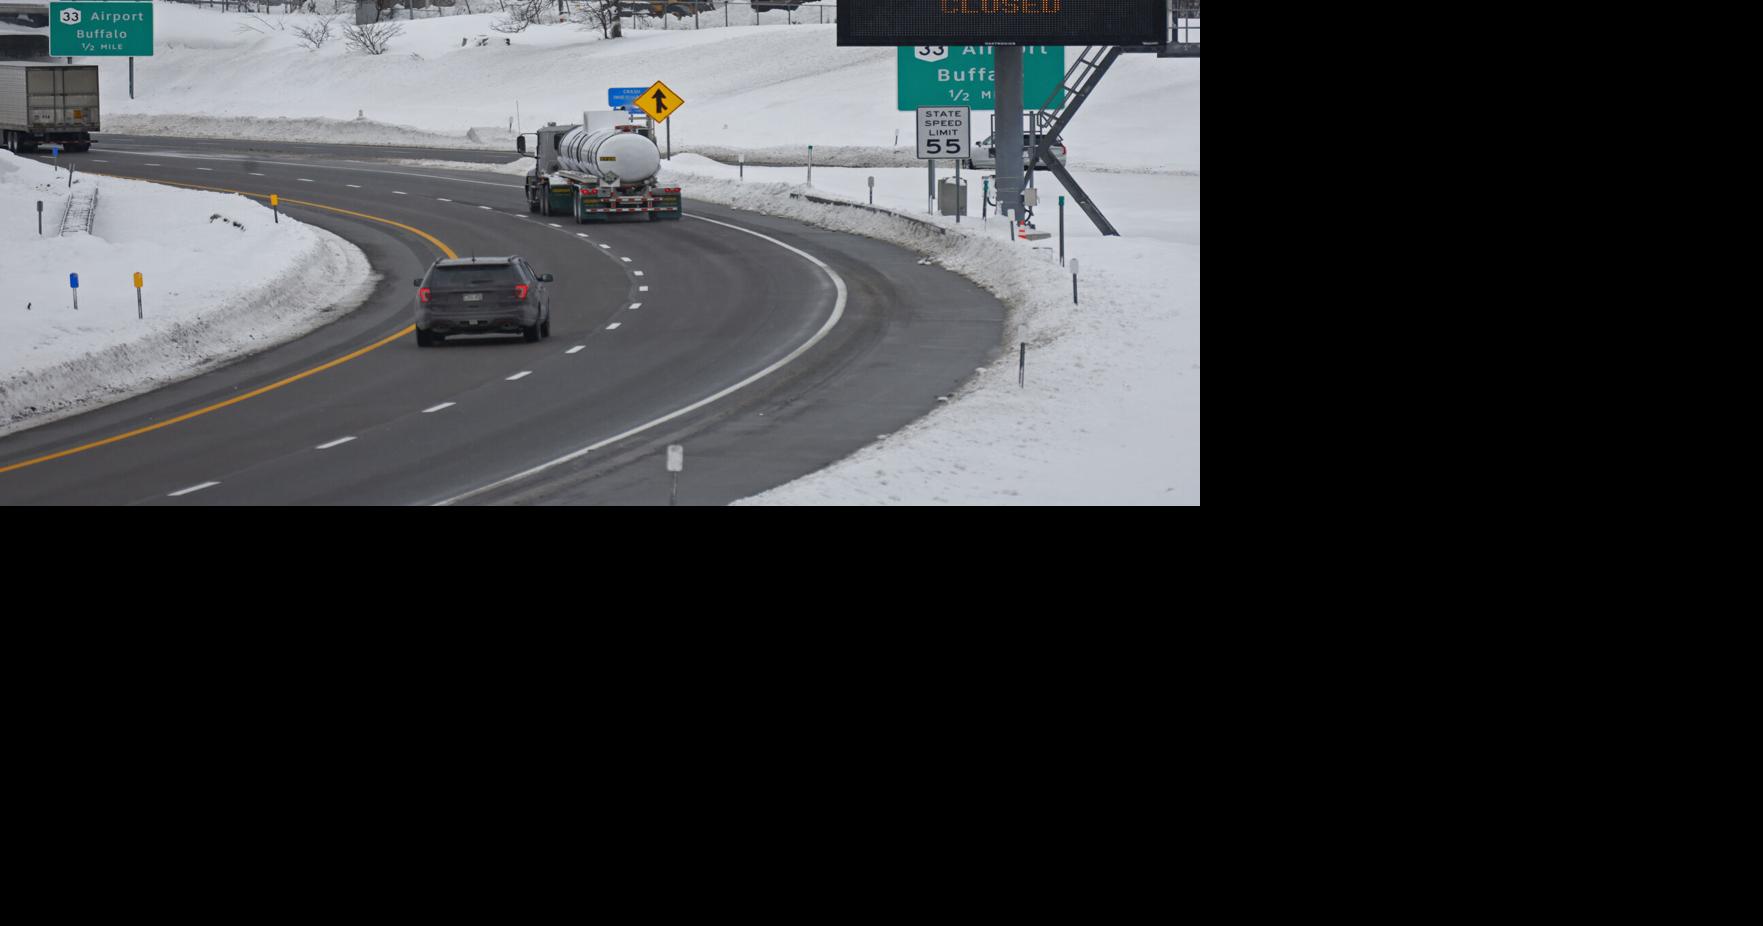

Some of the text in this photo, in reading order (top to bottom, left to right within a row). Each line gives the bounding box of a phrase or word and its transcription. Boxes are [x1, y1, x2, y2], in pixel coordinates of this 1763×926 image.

[941, 0, 1061, 13] CLOSED
[62, 12, 144, 23] 33 Airport
[77, 29, 127, 39] Buffalo
[918, 46, 1048, 56] 33 Airrt
[938, 67, 1024, 82] Buffa
[925, 110, 962, 118] STATE
[924, 119, 963, 127] SPEED
[928, 129, 959, 137] LIMIT
[926, 138, 961, 154] 55
